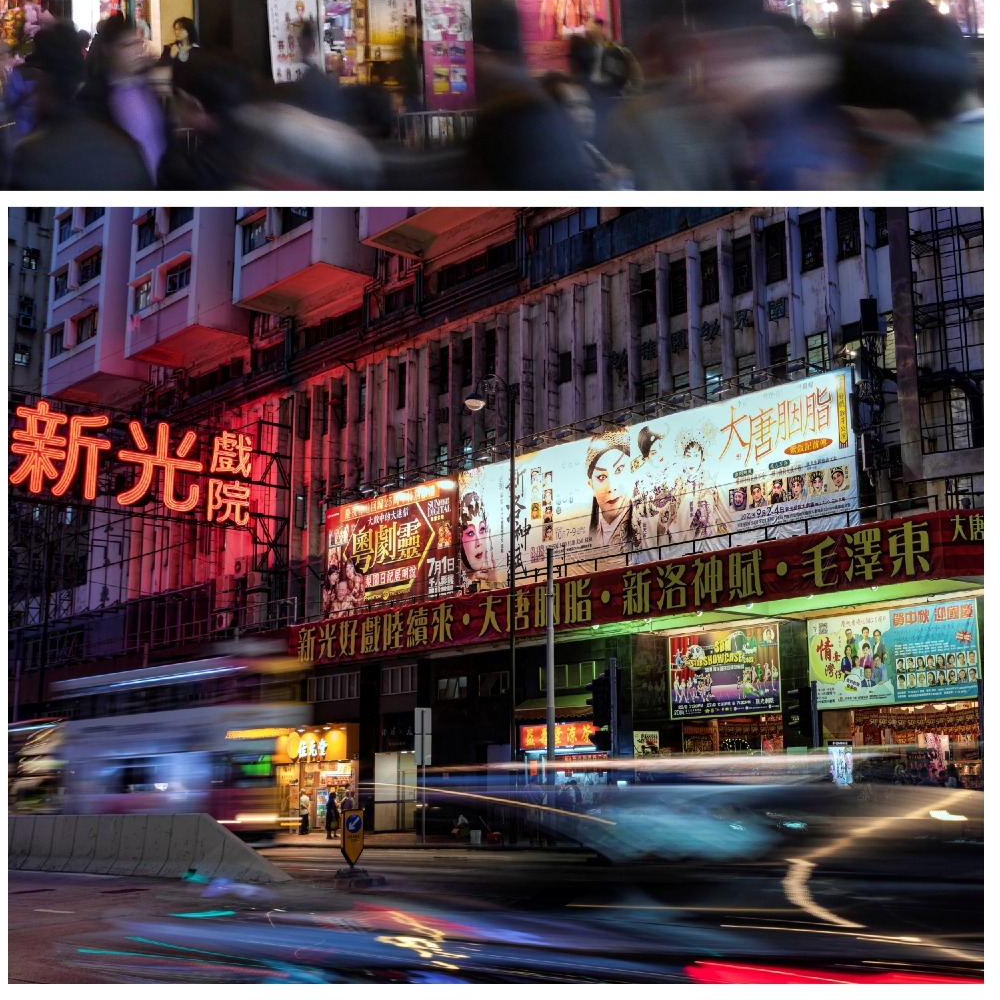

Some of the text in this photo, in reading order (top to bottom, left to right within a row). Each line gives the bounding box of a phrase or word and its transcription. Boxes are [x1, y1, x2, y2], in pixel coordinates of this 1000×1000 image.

[9, 401, 203, 512] 新光
[207, 431, 252, 526] 戲院
[427, 555, 455, 577] 7月1日
